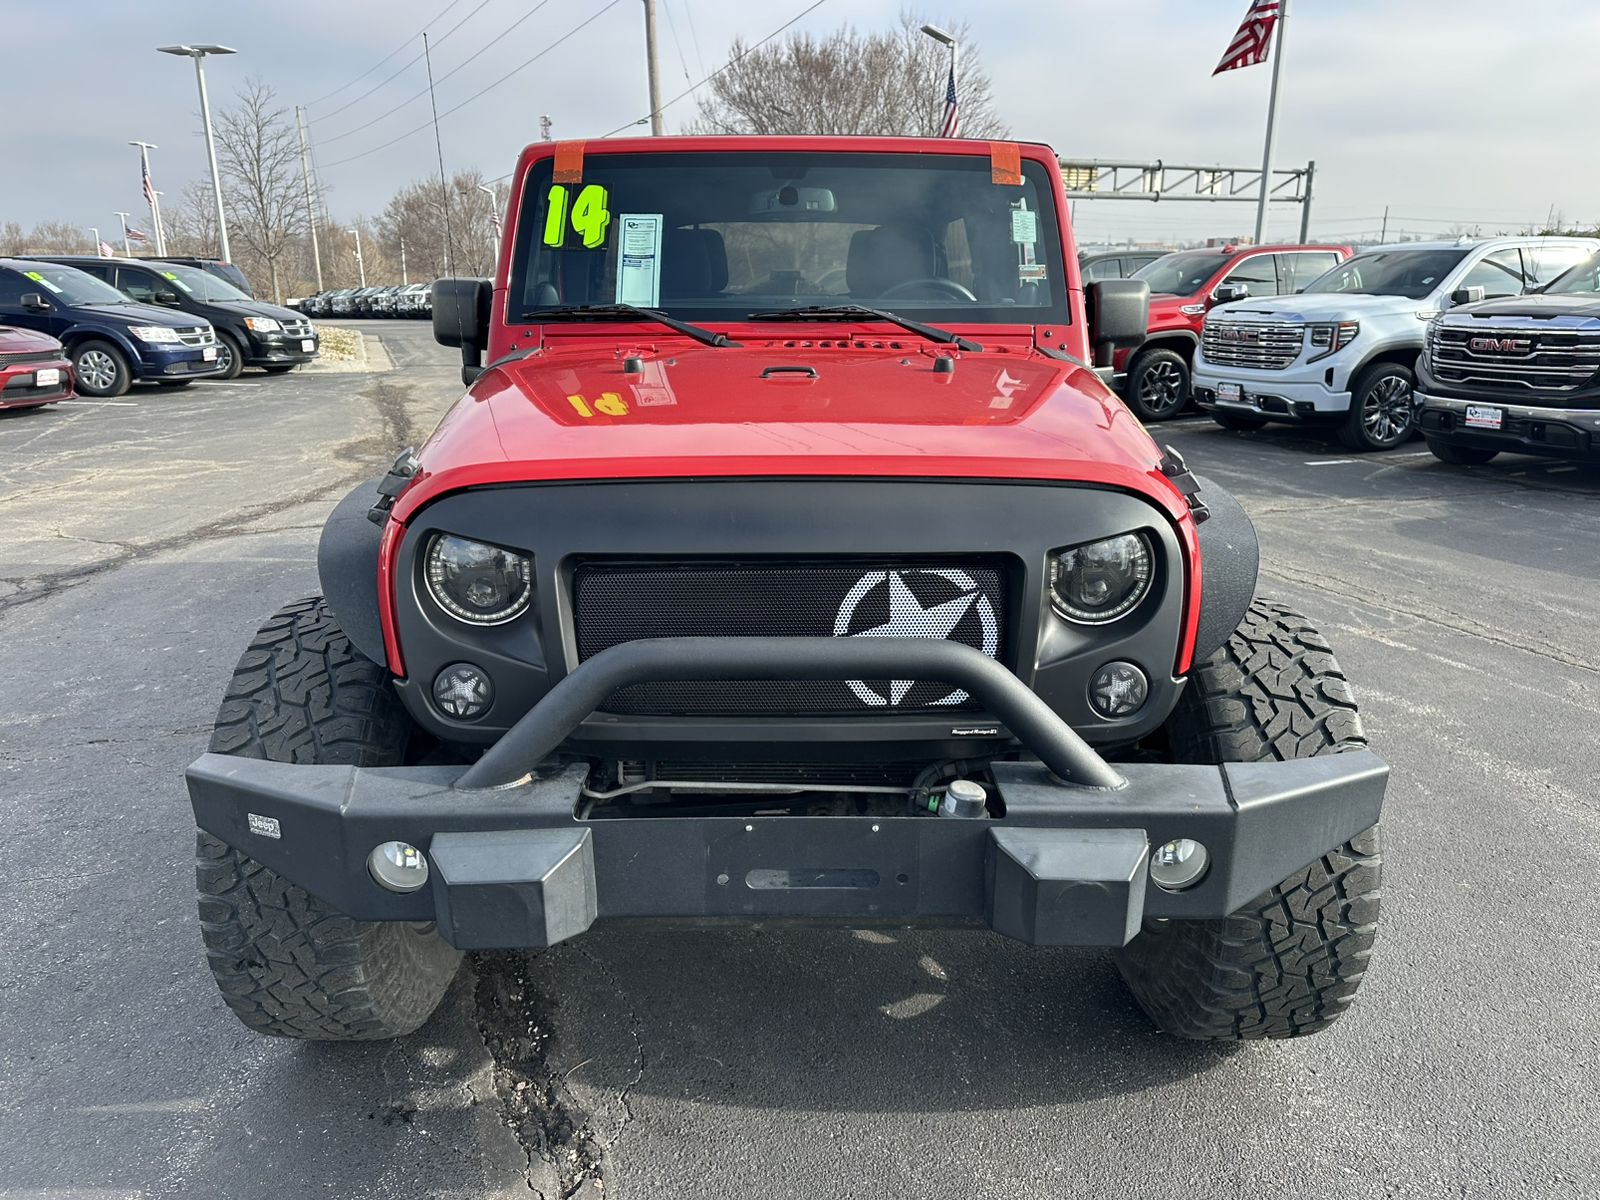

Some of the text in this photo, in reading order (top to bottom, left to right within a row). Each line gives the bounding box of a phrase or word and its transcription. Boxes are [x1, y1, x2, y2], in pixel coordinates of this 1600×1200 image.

[543, 184, 611, 249] 14
[1221, 330, 1258, 342] GMC
[1470, 337, 1531, 353] GMC
[251, 817, 275, 832] Jeep
